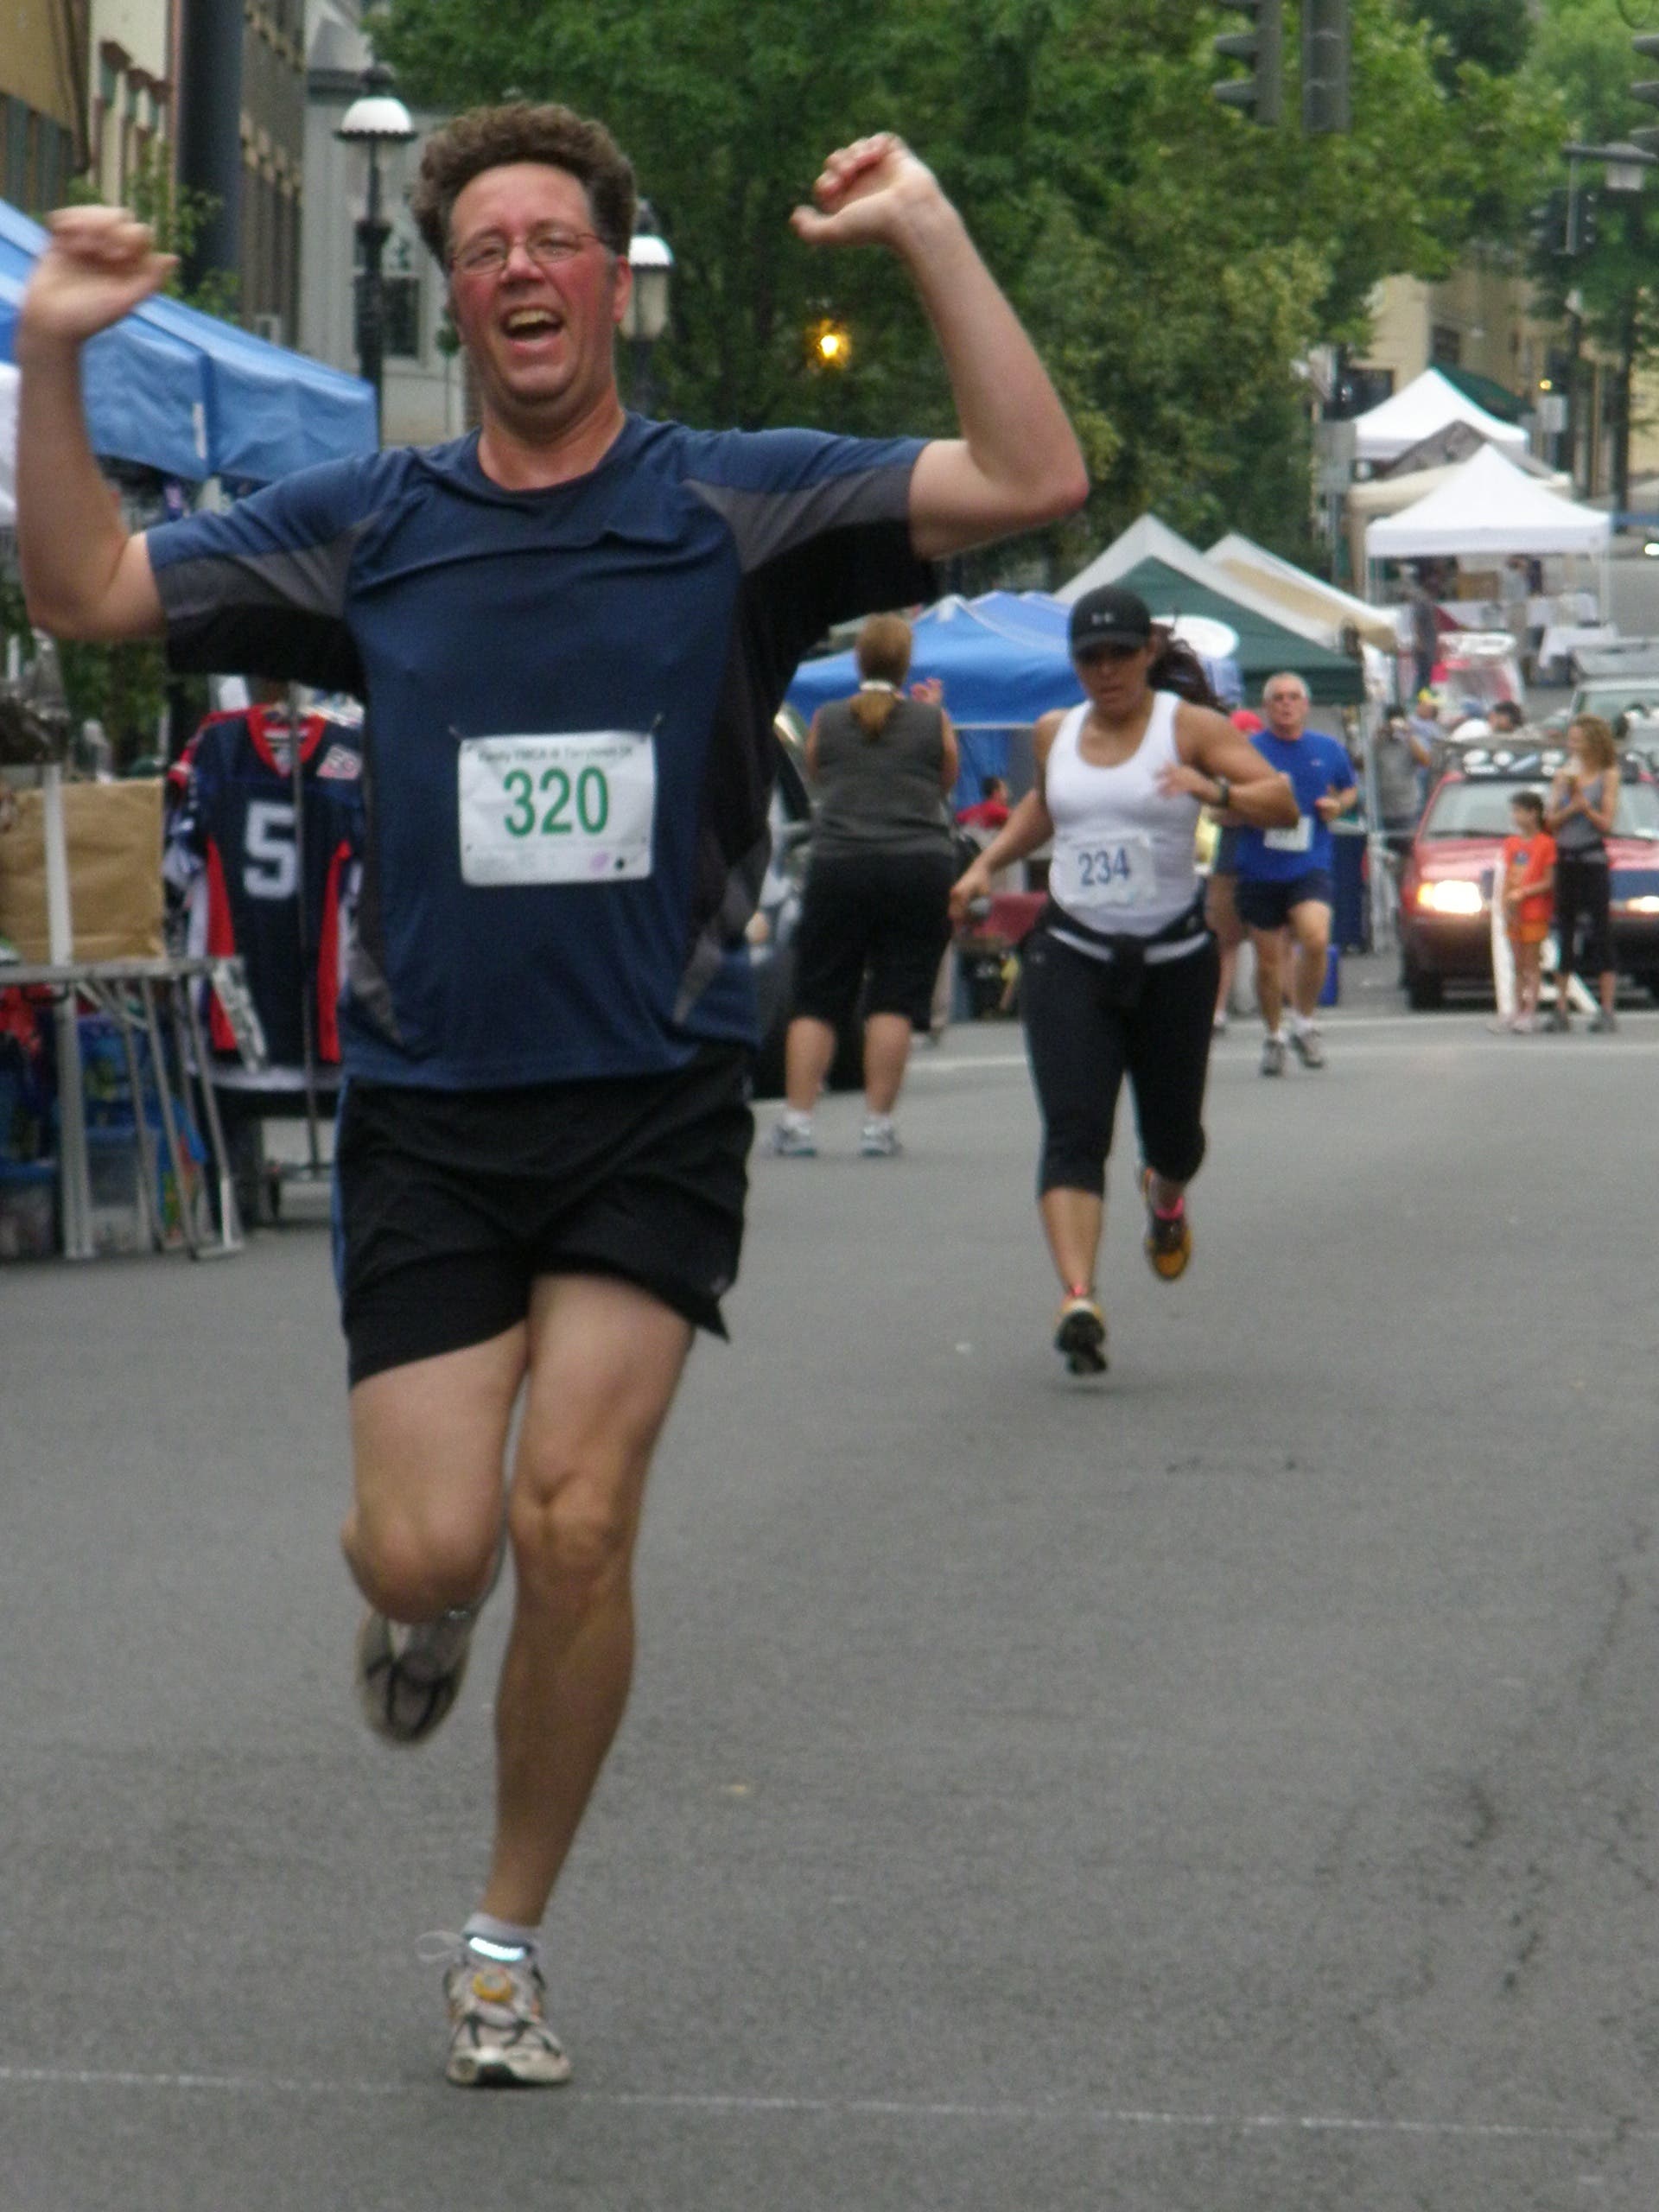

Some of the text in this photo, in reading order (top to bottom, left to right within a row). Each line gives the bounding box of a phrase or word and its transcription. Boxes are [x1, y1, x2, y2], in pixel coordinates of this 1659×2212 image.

[503, 766, 609, 838] 320
[243, 800, 300, 900] 5
[1077, 847, 1130, 887] 234
